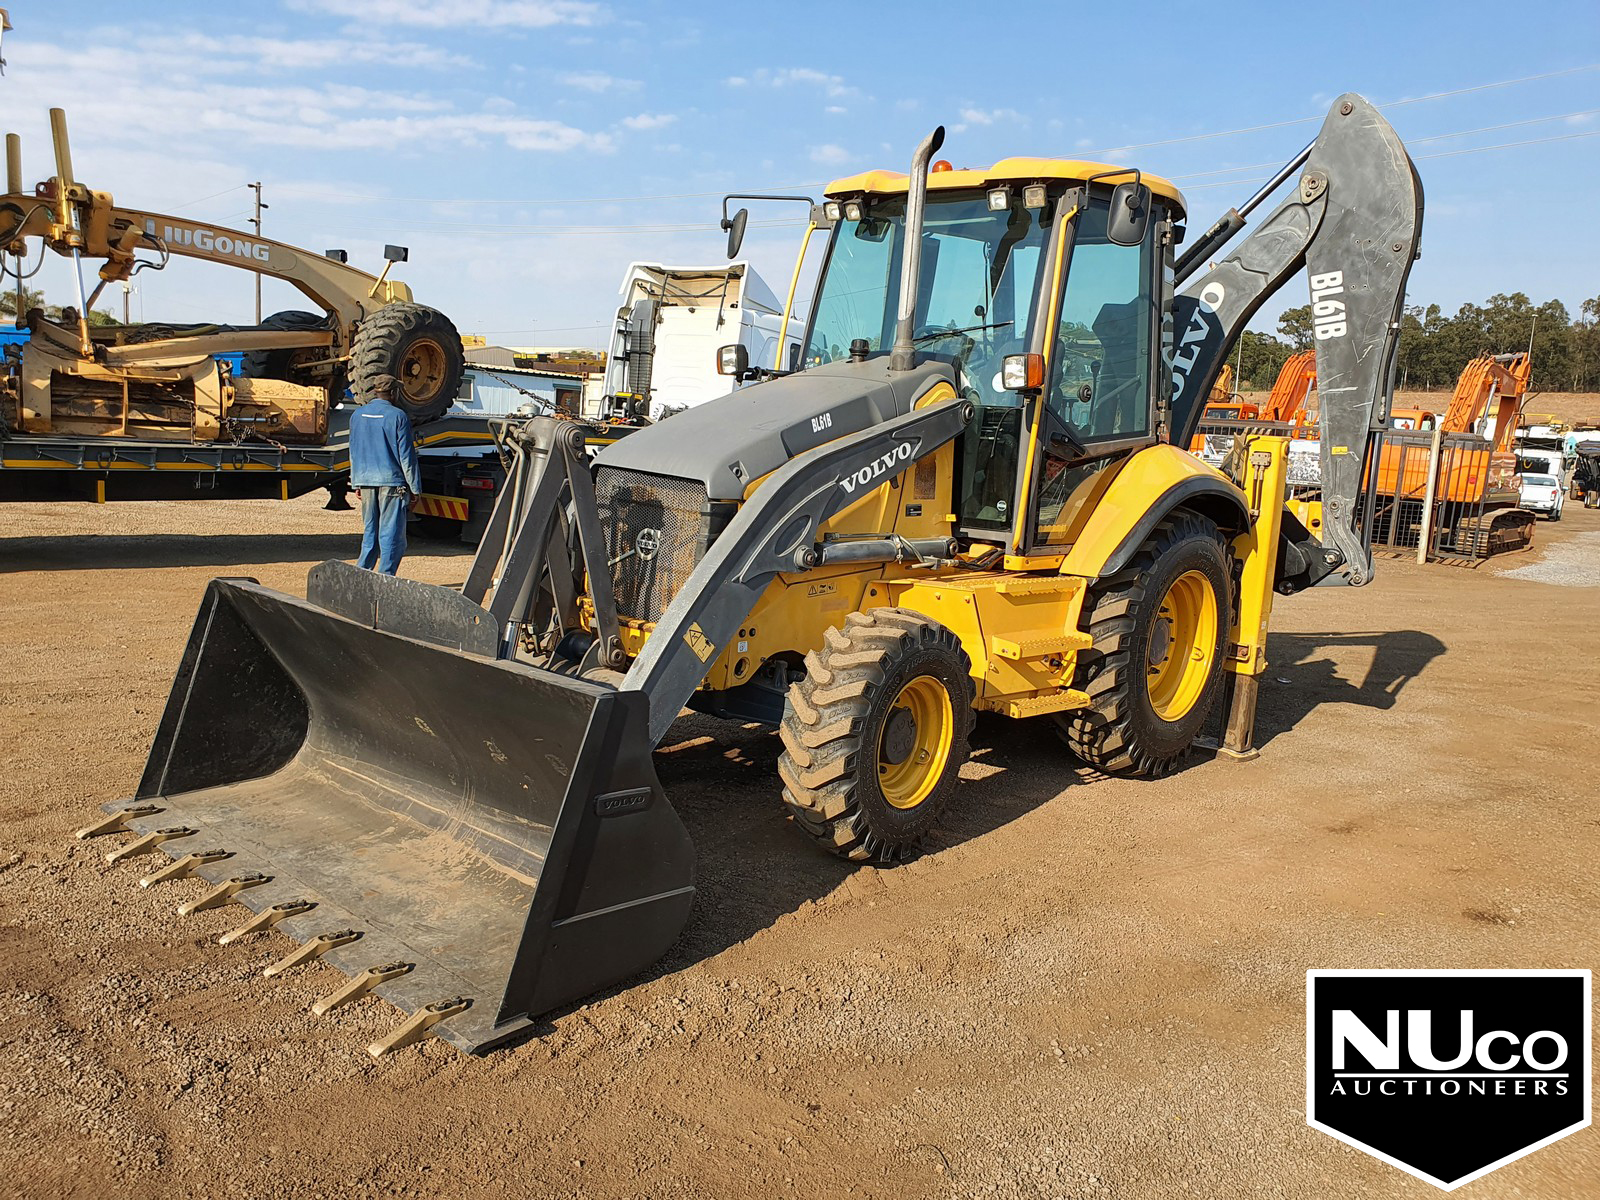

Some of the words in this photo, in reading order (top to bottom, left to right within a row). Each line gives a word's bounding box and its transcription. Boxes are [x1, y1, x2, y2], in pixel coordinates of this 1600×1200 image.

[1310, 270, 1347, 340] BL61B
[1162, 281, 1225, 402] OLVO
[811, 412, 832, 433] BL61B
[840, 442, 912, 494] VOLVO
[604, 796, 646, 810] VOLVO
